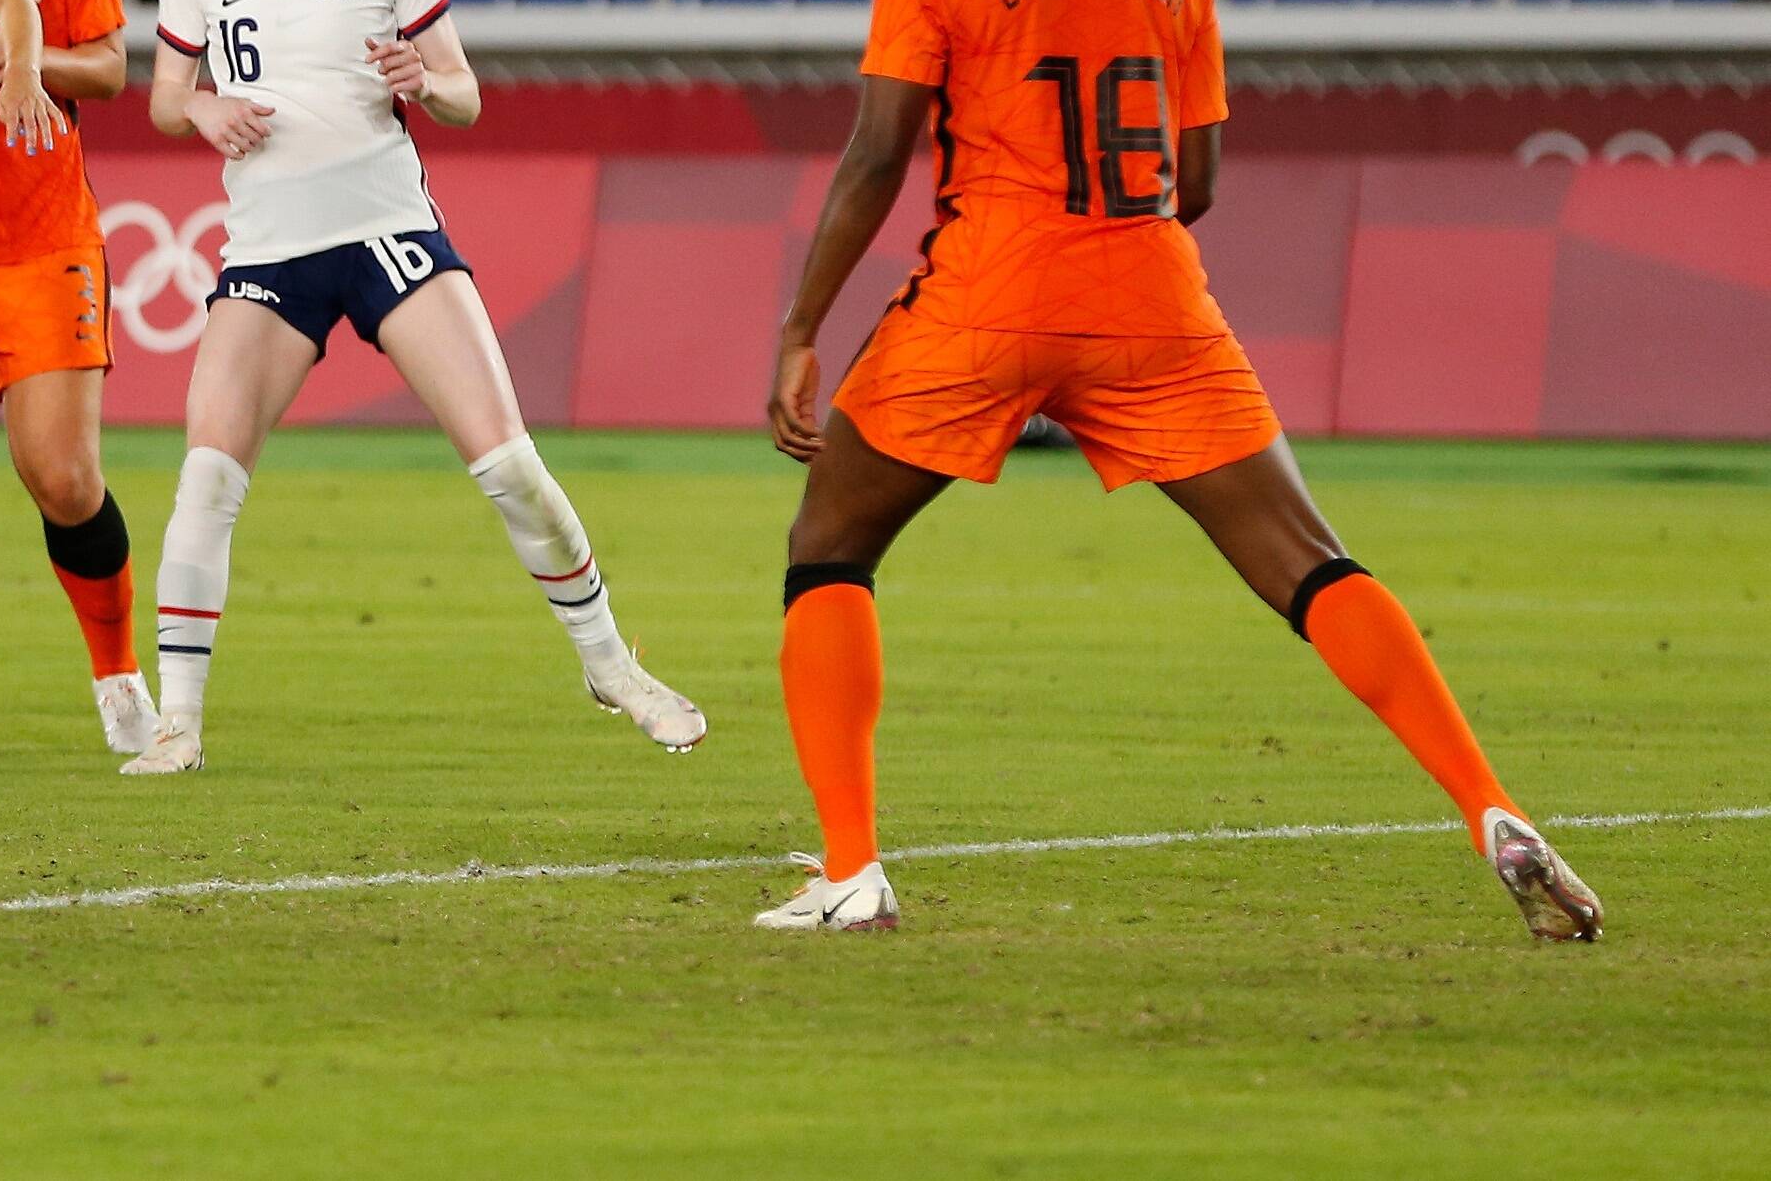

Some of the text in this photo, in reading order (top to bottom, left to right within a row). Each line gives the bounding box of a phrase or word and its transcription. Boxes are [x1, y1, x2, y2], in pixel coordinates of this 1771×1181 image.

[219, 18, 261, 83] 16
[1023, 55, 1176, 219] 18
[364, 234, 434, 295] 16
